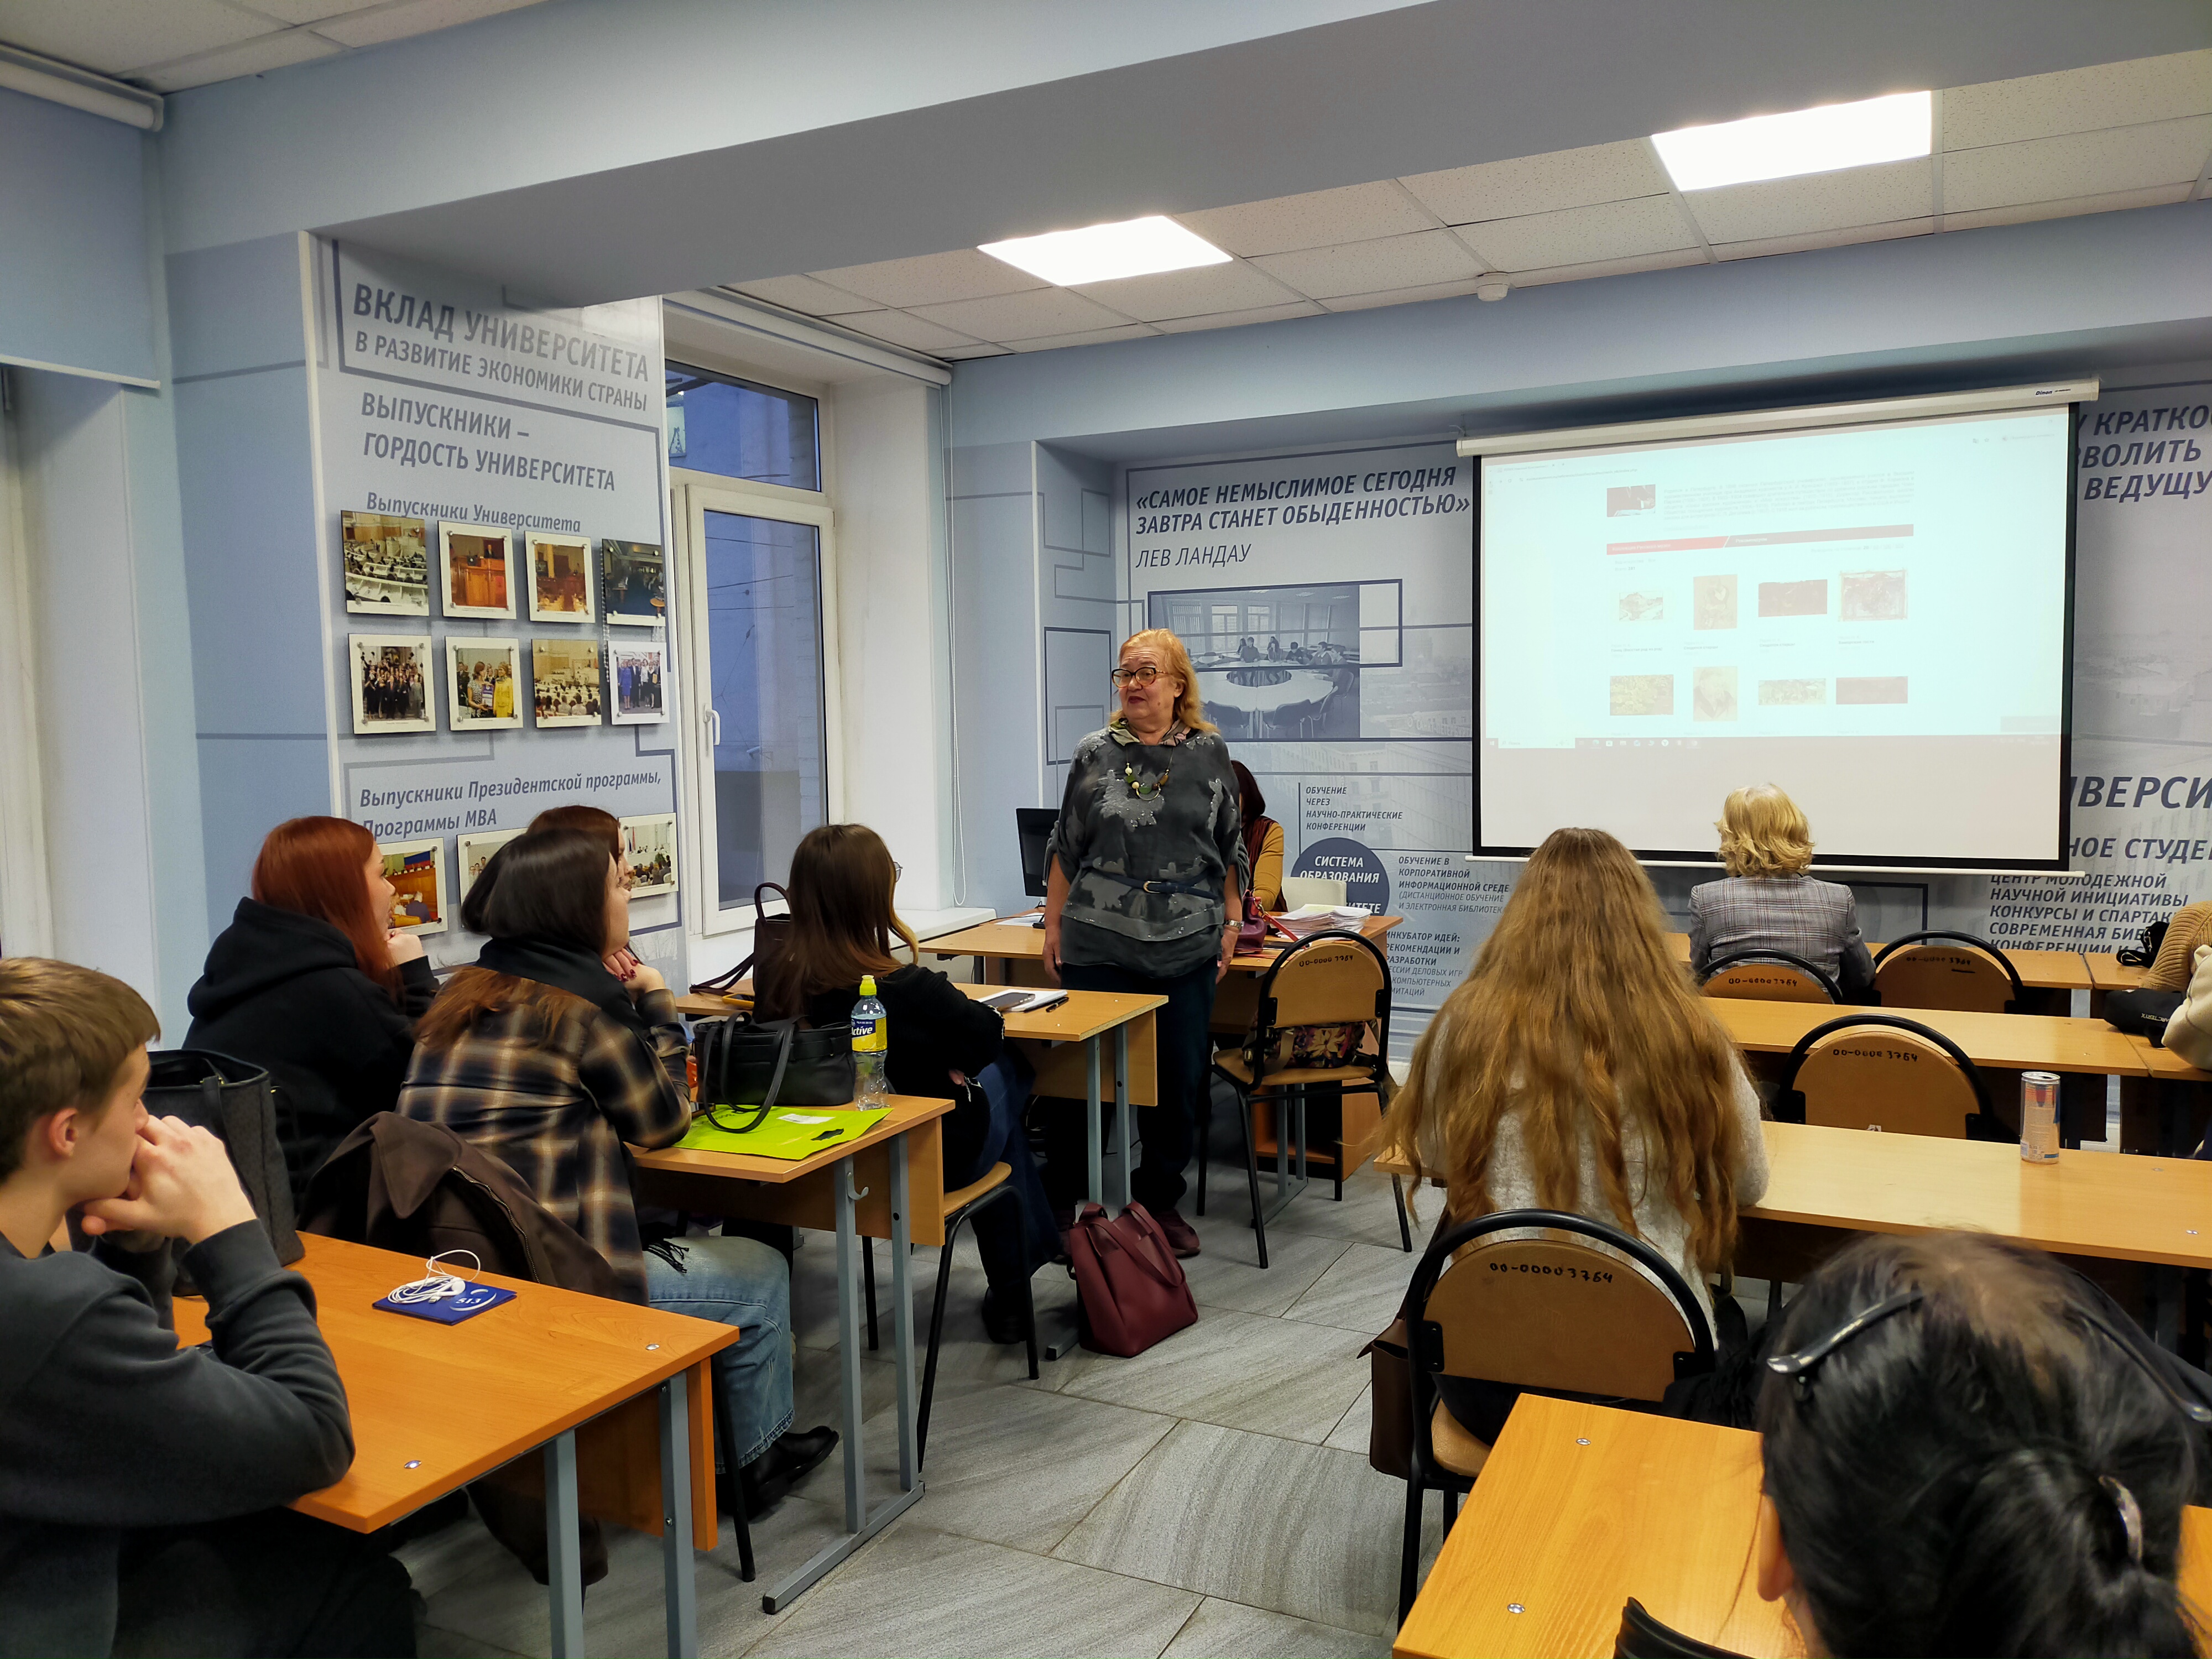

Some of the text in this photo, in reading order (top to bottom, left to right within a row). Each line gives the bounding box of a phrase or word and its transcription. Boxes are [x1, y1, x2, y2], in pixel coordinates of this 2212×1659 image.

[353, 283, 649, 382] ВКЛАД УНИВЕРСИТЕТА
[355, 330, 648, 411] В РАЗВИТИЕ ЭКОНОМИКИ СТРАНЫ
[361, 392, 512, 440] ВЫПУСКНИКИ
[2094, 404, 2212, 436] КРАТКО
[363, 432, 615, 491] ГОРДОСТЬ УНИВЕРСИТЕТА
[2078, 439, 2201, 469] ВОЛИТЬ
[1136, 466, 1457, 510] «САМОЕ НЕМЫСЛИМОЕ СЕГОДНЯ
[367, 492, 581, 534] Выпускники Университета
[1135, 493, 1471, 535] ЗАВТРА СТАНЕТ ОБЫДЕННОСТЬЮ»
[1135, 543, 1252, 568] ЛЕВ ЛАНДАУ
[359, 768, 661, 810] Выпускники Президентской программы,
[1306, 786, 1347, 795] ОБУЧЕНИЕ
[1306, 810, 1403, 819] НАУЧНО-ПРАКТИЧЕСКИЕ
[364, 808, 497, 841] Программы МВА
[1306, 822, 1366, 832] КОНФЕРЕНЦИИ
[1399, 856, 1442, 865] ОБУЧЕНИЕ
[2125, 838, 2212, 864] СТУДЕ
[1314, 855, 1364, 868] СИСТЕМА
[1399, 868, 1470, 878] КОРПОРАТИВНОЙ
[1399, 880, 1510, 893] ИНФОРМАЦИОННОЙ СРЕДЕ
[1465, 894, 1505, 902] ОБУЧЕНИЕ
[1990, 887, 2189, 907] НАУЧНОЙ ИНИЦИАТИВЫ
[1406, 902, 1457, 912] ЭЛЕКТРОННАЯ
[1990, 905, 2176, 924] КОНКУРСЫ И СПАРТАК
[1434, 932, 1460, 943] ИДЕЙ:
[1989, 922, 2107, 940] СОВРЕМЕННАЯ
[1411, 967, 1447, 976] ДЕЛОВЫХ
[1448, 969, 1463, 977] ИГР
[1392, 977, 1452, 987] КОМПЬЮТЕРНЫХ
